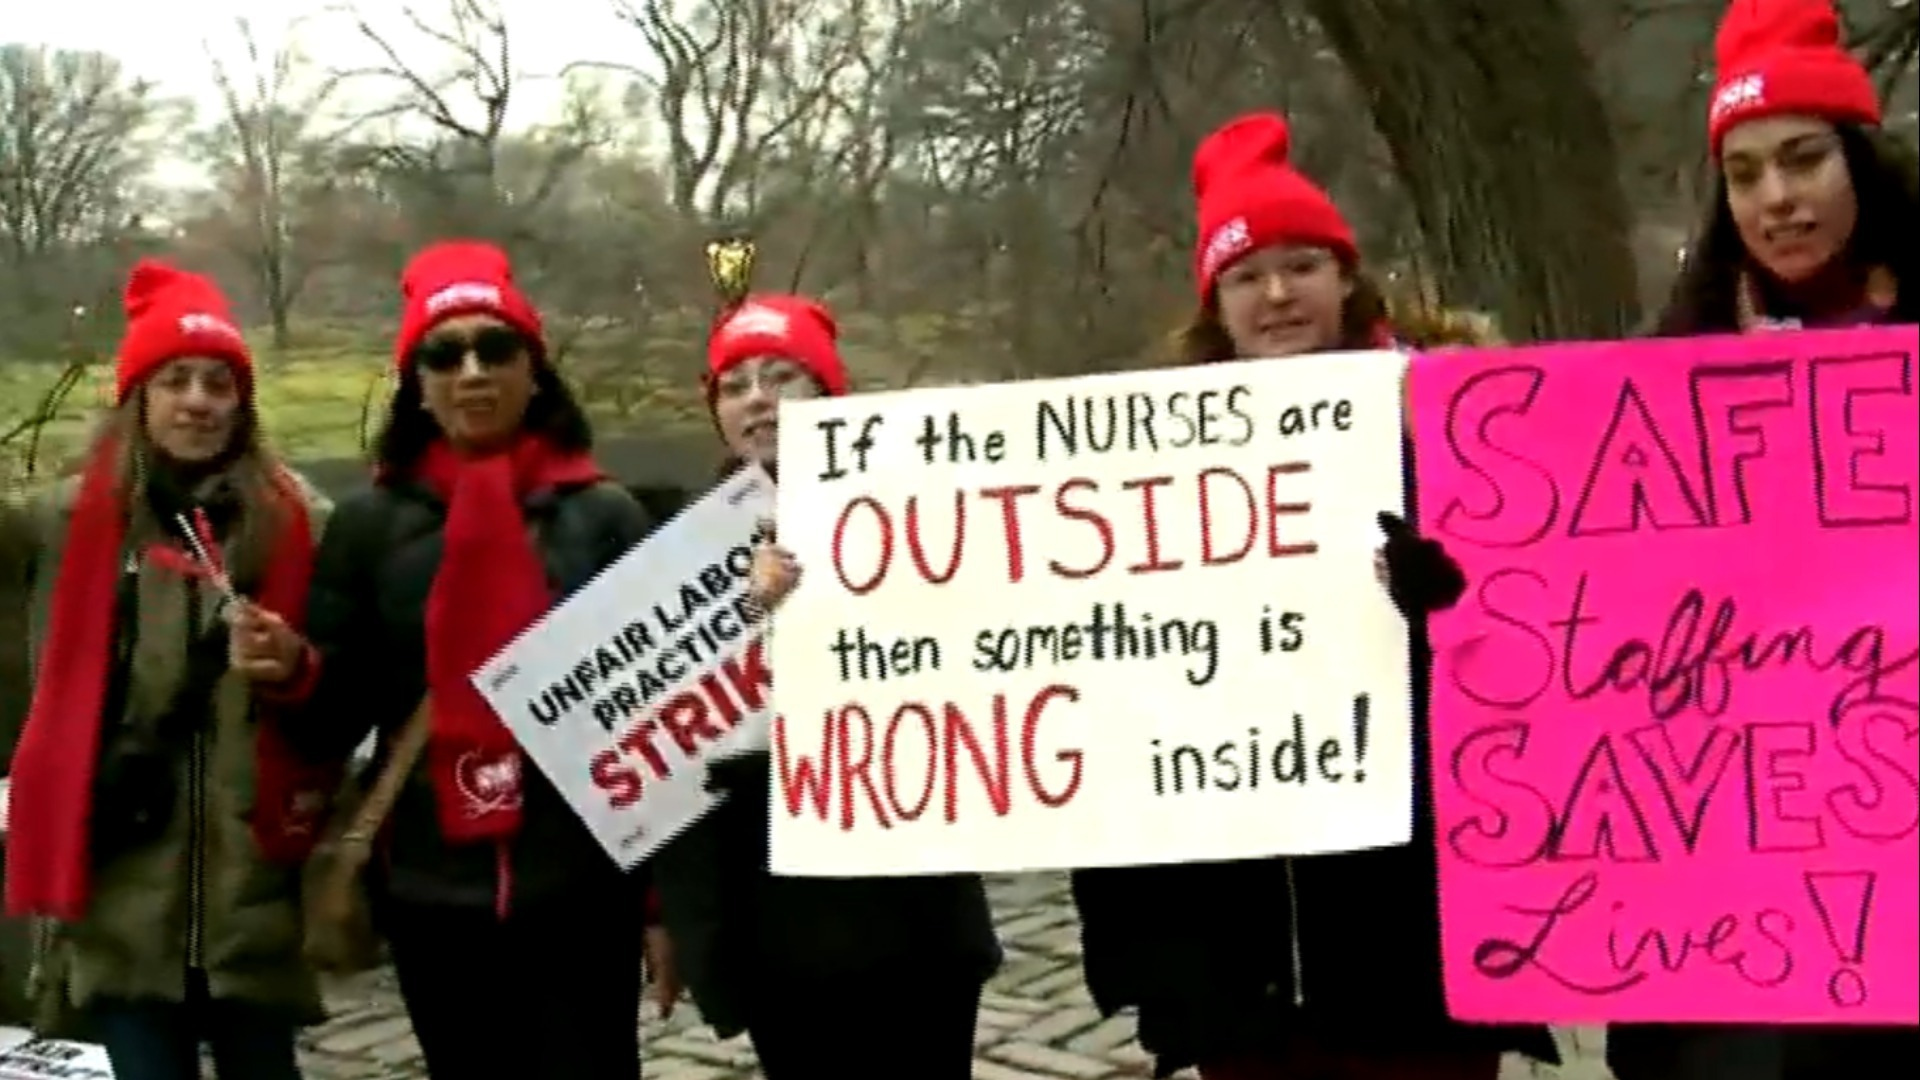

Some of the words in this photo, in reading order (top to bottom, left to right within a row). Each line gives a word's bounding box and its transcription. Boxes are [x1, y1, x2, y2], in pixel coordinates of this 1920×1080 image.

[817, 414, 884, 483] If
[915, 412, 1006, 464] the
[1036, 386, 1254, 460] NURSES
[1278, 397, 1353, 436] are
[1437, 351, 1912, 548] SAFE
[832, 461, 1320, 596] OUTSIDE
[529, 617, 654, 727] UNFAIR
[830, 628, 941, 682] then
[972, 602, 1219, 687] something
[1260, 606, 1305, 655] is
[1450, 567, 1920, 726] Staffing
[590, 634, 773, 809] STRIK
[774, 684, 1085, 831] WRONG
[1151, 693, 1372, 797] inside!
[1446, 696, 1919, 868] SAVES
[1473, 869, 1877, 1009] Lives!
